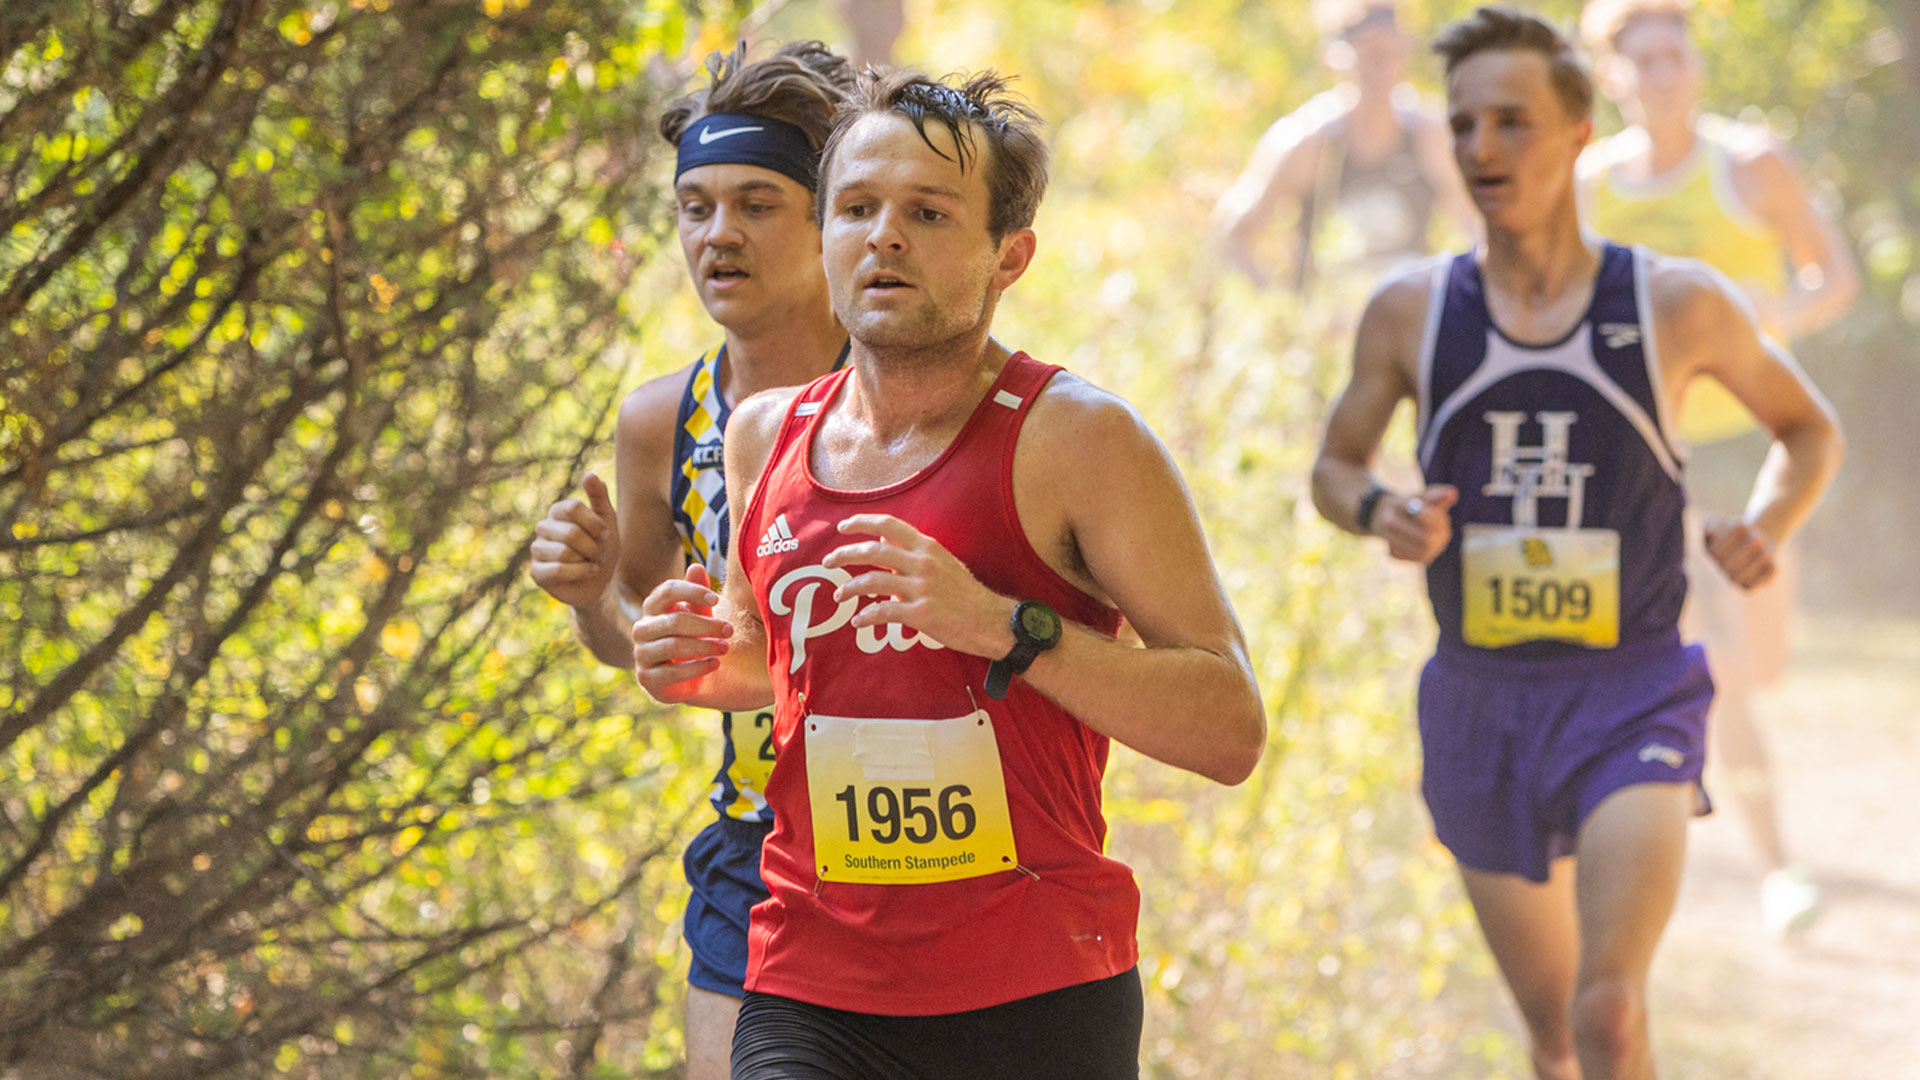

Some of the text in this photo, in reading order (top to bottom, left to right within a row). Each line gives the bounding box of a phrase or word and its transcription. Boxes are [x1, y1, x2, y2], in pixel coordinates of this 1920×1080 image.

[756, 538, 799, 558] adidas
[1485, 575, 1592, 622] 1509
[835, 784, 977, 844] 1956
[845, 851, 976, 870] Southern Stampede
